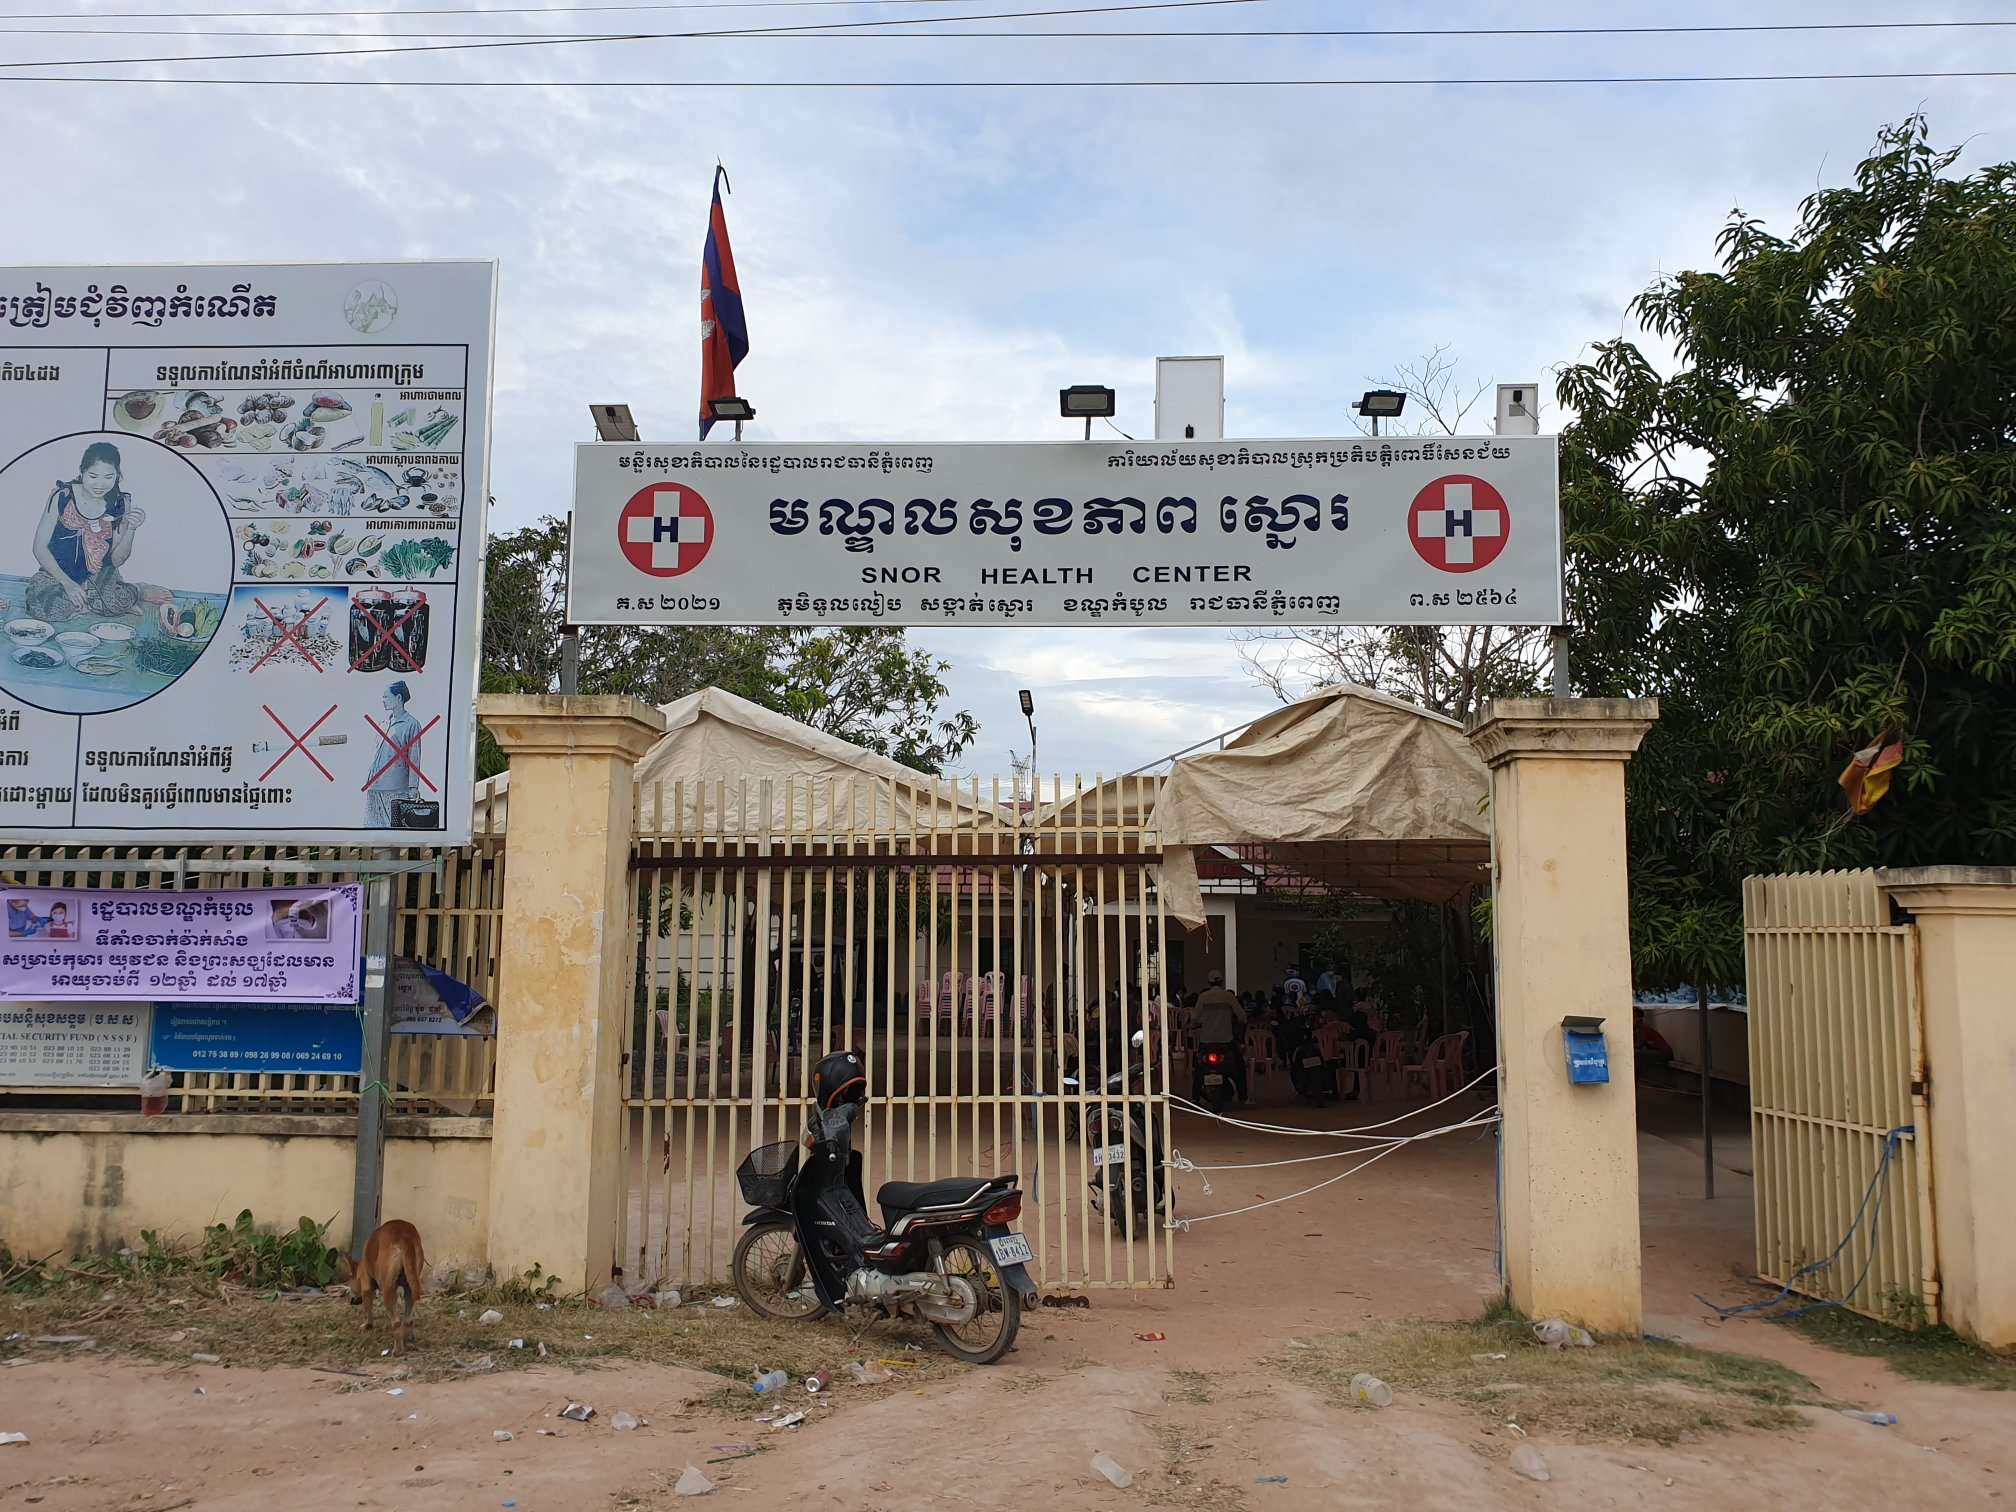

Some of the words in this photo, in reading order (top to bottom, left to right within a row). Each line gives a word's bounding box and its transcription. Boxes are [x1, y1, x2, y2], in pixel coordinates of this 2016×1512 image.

[862, 567, 941, 583] SNOR
[982, 568, 1092, 584] HEALTH
[1133, 566, 1251, 583] CENTER
[70, 1033, 94, 1041] FUND
